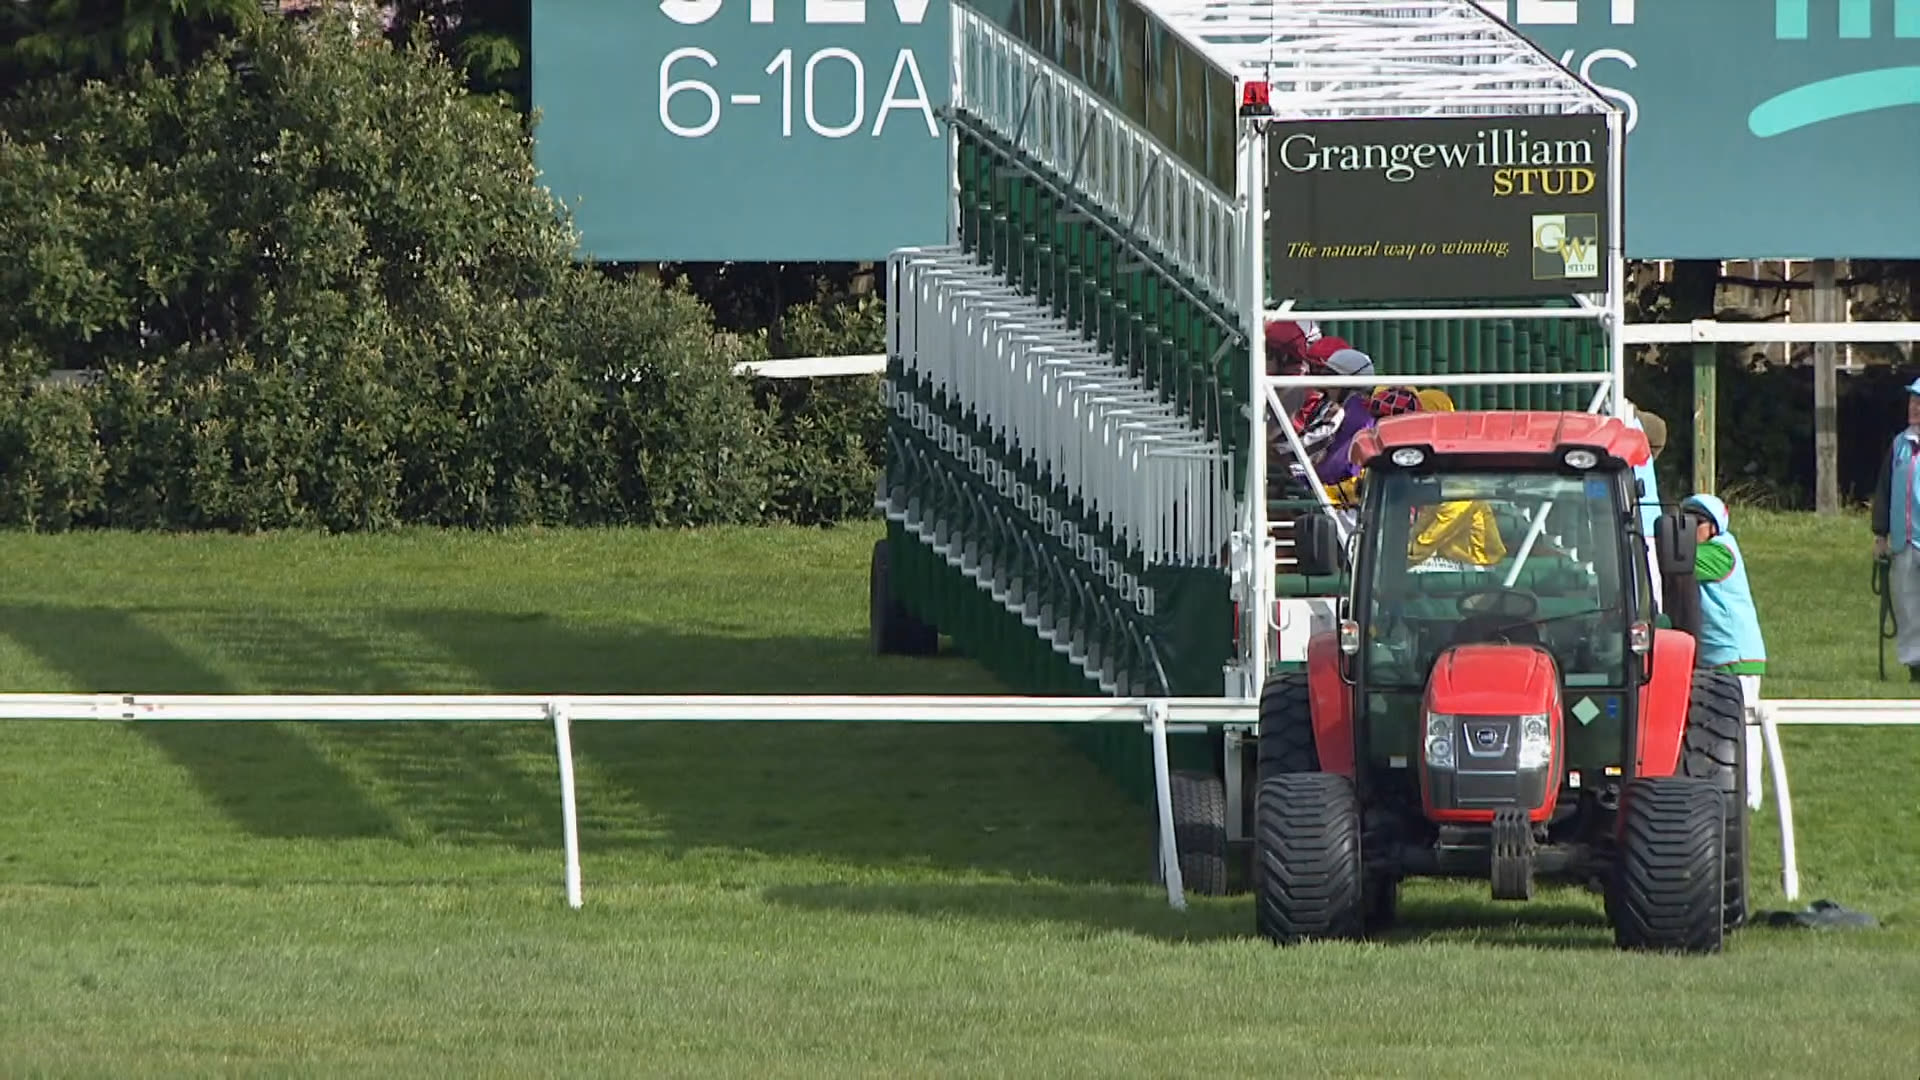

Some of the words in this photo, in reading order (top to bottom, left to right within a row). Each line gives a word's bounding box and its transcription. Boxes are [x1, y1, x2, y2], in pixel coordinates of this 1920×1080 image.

[1279, 128, 1594, 183] Grangewilliam
[1492, 167, 1597, 197] STUD
[1287, 240, 1317, 259] The
[1320, 240, 1380, 258] natural
[1383, 242, 1416, 261] way
[1420, 241, 1437, 256] to
